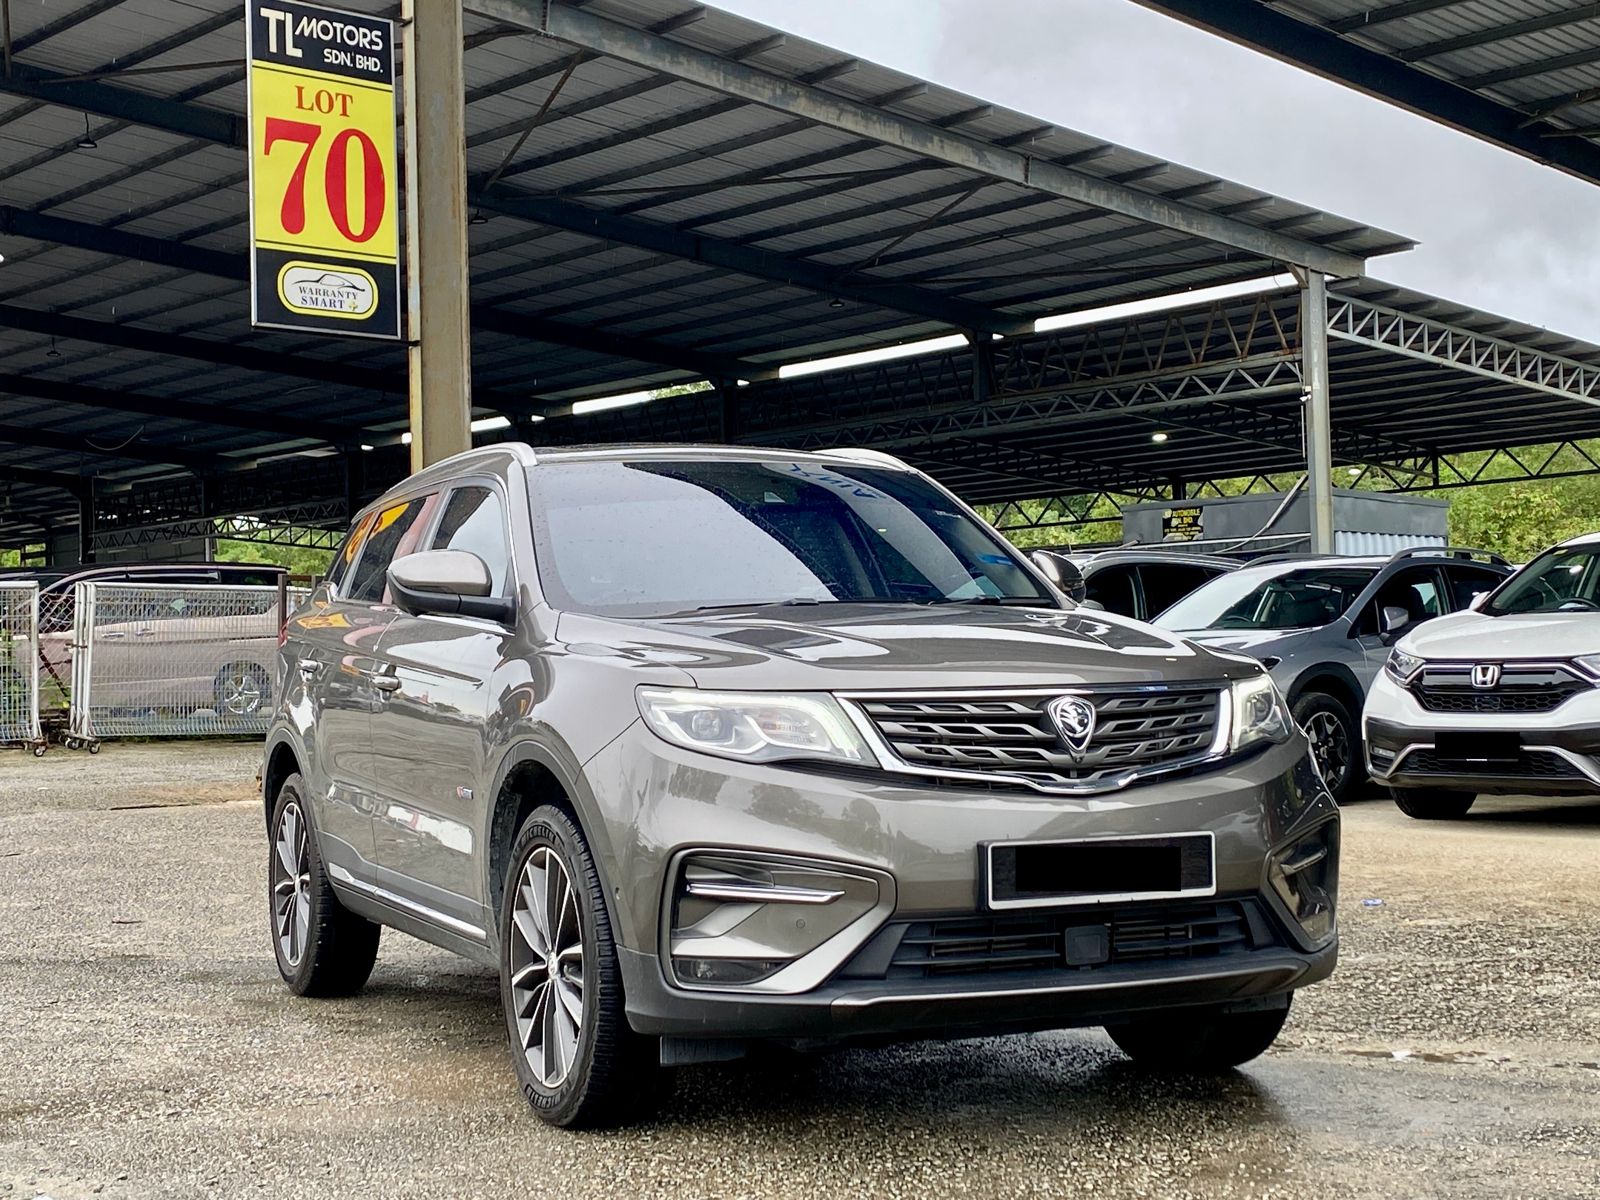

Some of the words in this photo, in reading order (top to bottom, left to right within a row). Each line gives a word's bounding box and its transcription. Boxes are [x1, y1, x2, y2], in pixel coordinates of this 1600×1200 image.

[295, 16, 383, 50] MOTORS
[356, 54, 383, 73] BHD.
[295, 86, 354, 117] LOT
[263, 117, 385, 243] 70
[299, 286, 358, 300] WARRANTY
[301, 296, 345, 309] SMART
